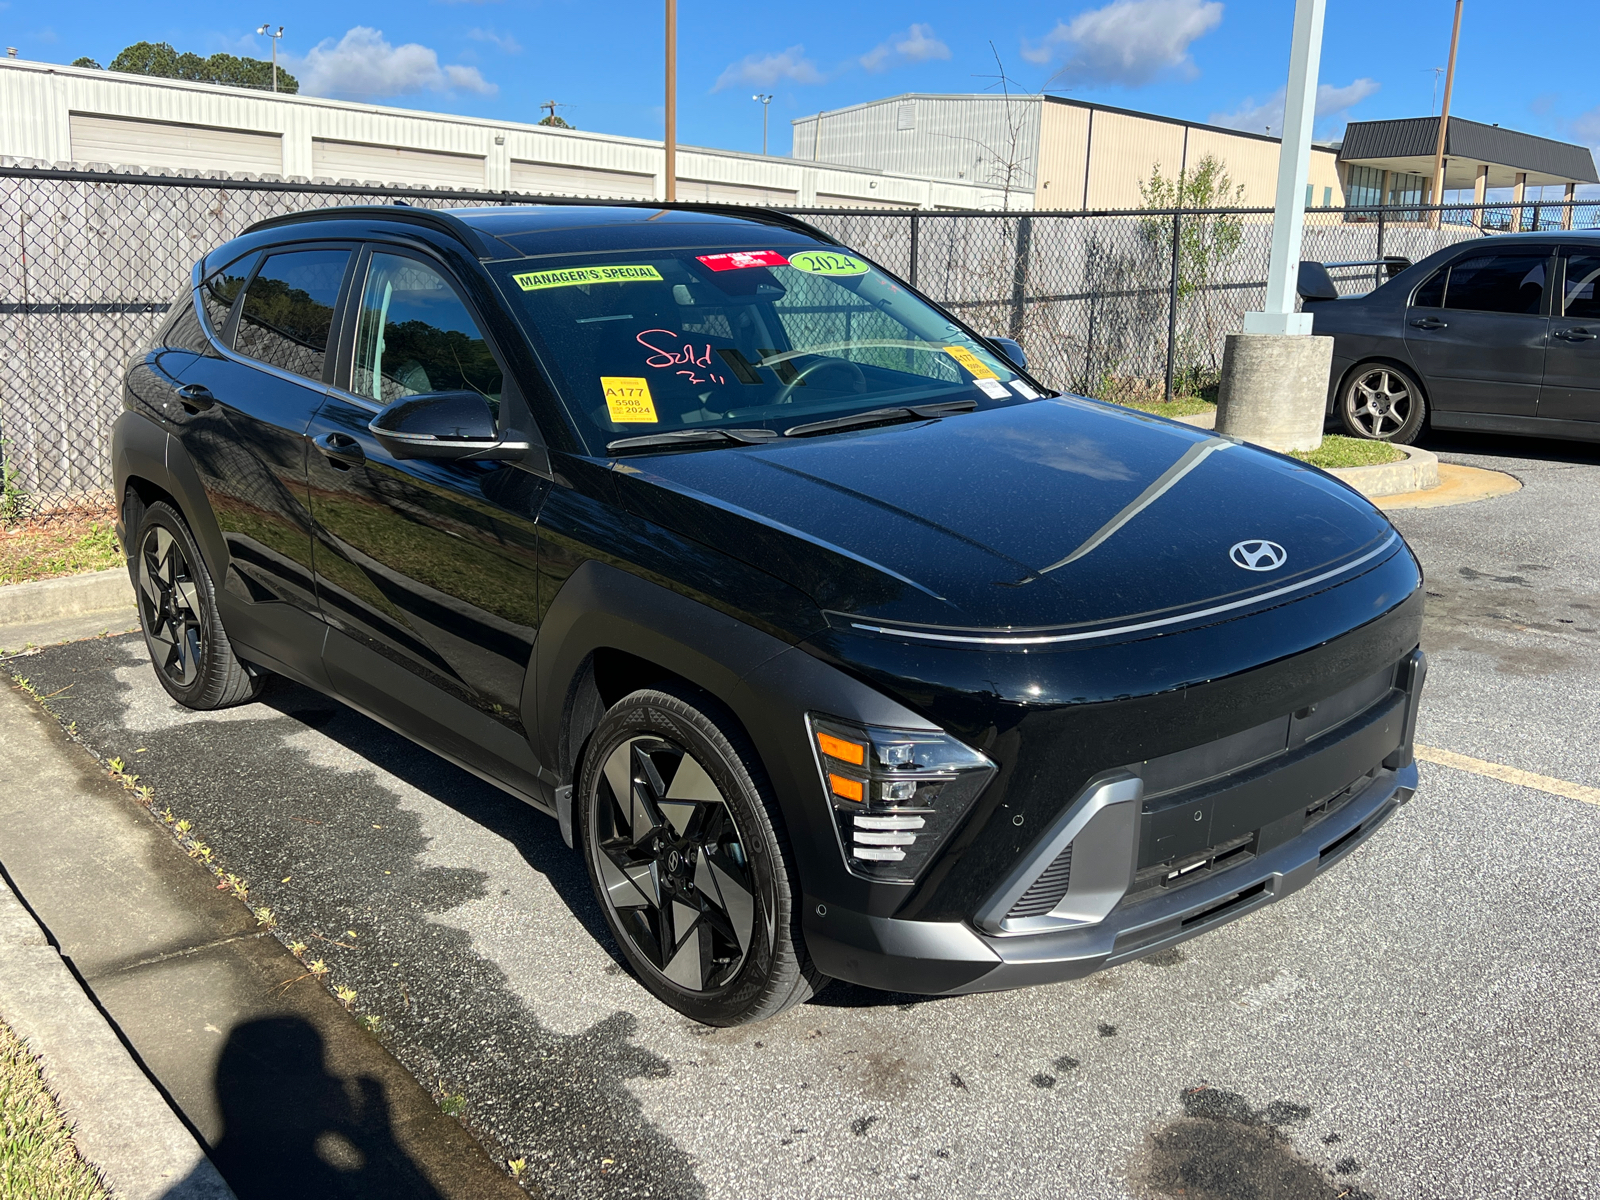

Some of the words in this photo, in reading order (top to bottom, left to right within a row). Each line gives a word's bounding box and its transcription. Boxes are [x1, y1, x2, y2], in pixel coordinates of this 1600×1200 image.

[802, 256, 857, 271] 2024
[519, 269, 600, 287] MANAGER'S
[603, 267, 656, 279] SPECIAL
[636, 328, 711, 368] Sold
[605, 387, 644, 397] A177
[615, 399, 641, 407] 5508
[626, 406, 650, 414] 2024
